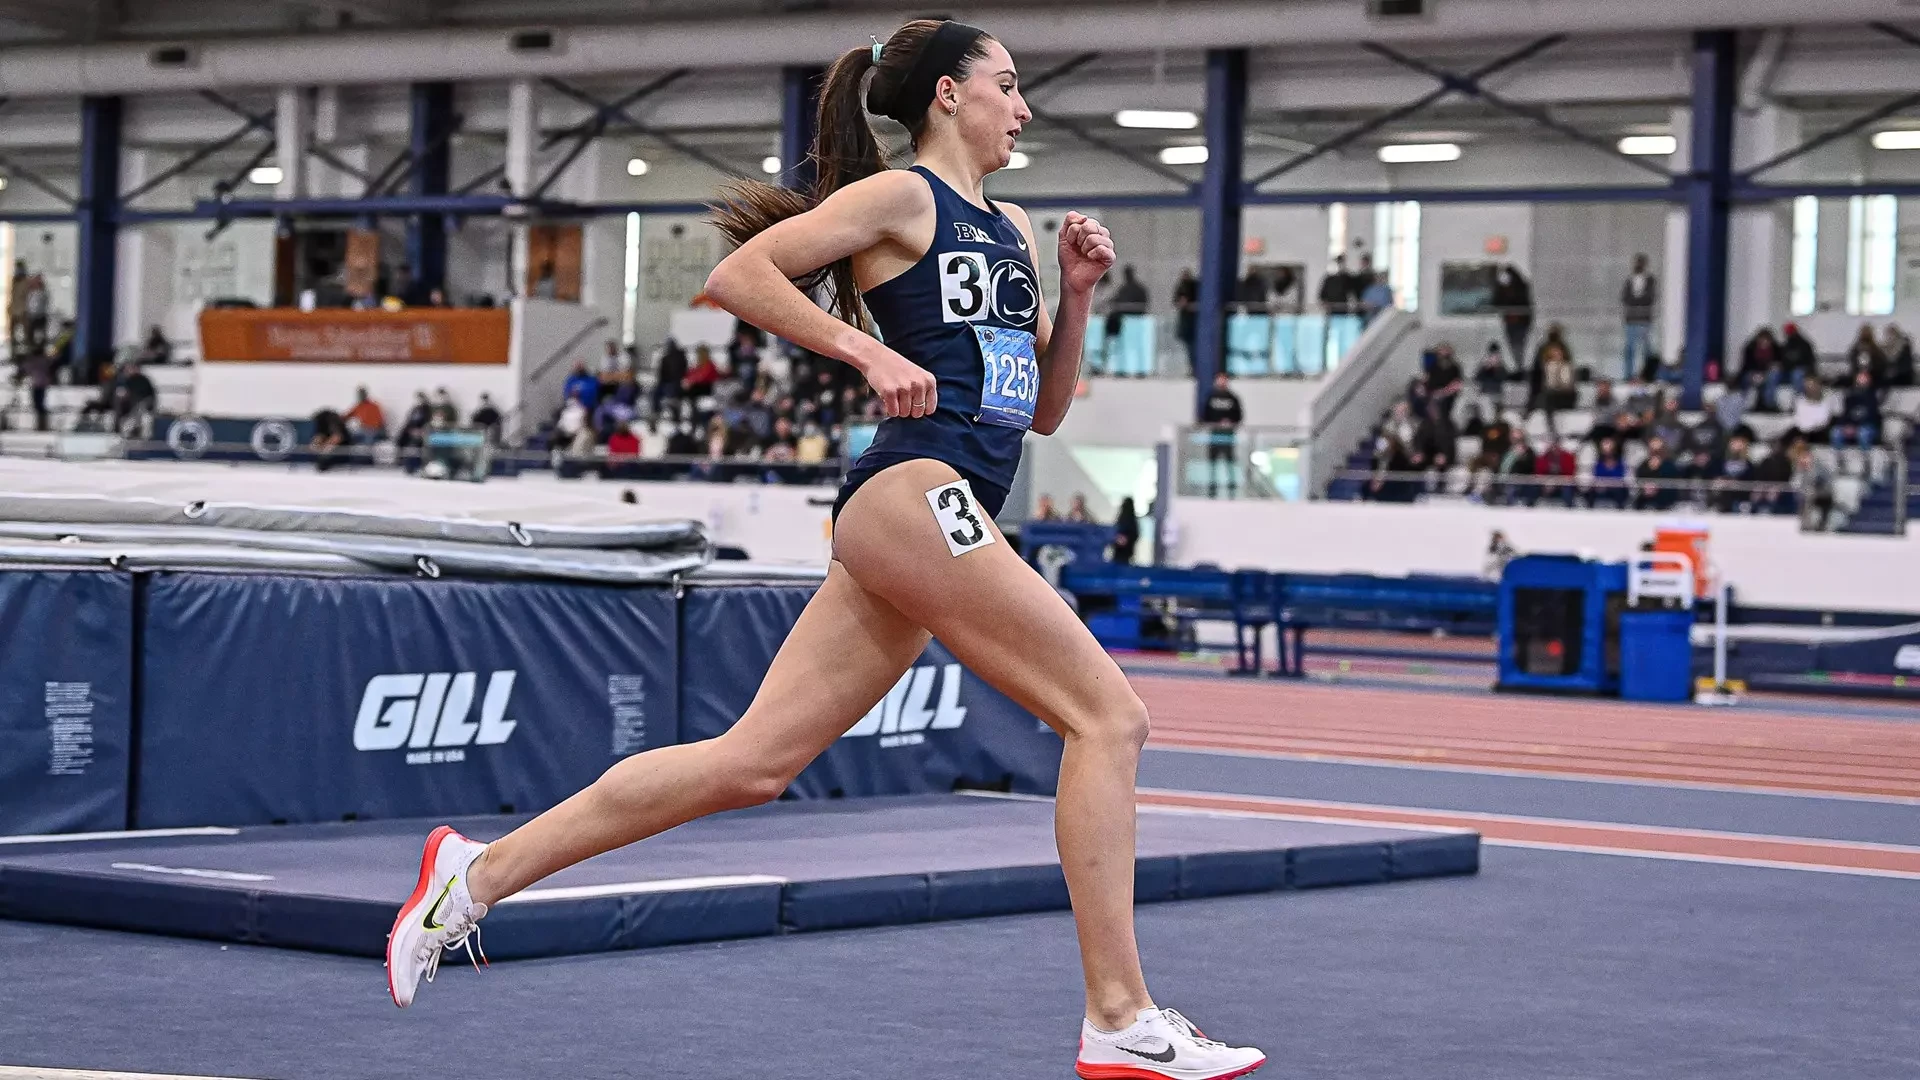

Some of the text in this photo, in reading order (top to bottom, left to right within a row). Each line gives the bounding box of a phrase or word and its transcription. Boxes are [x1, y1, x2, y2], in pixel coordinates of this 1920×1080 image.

[946, 255, 984, 317] 3
[985, 351, 1039, 404] 1253
[937, 487, 984, 546] 3
[353, 669, 517, 751] GILL
